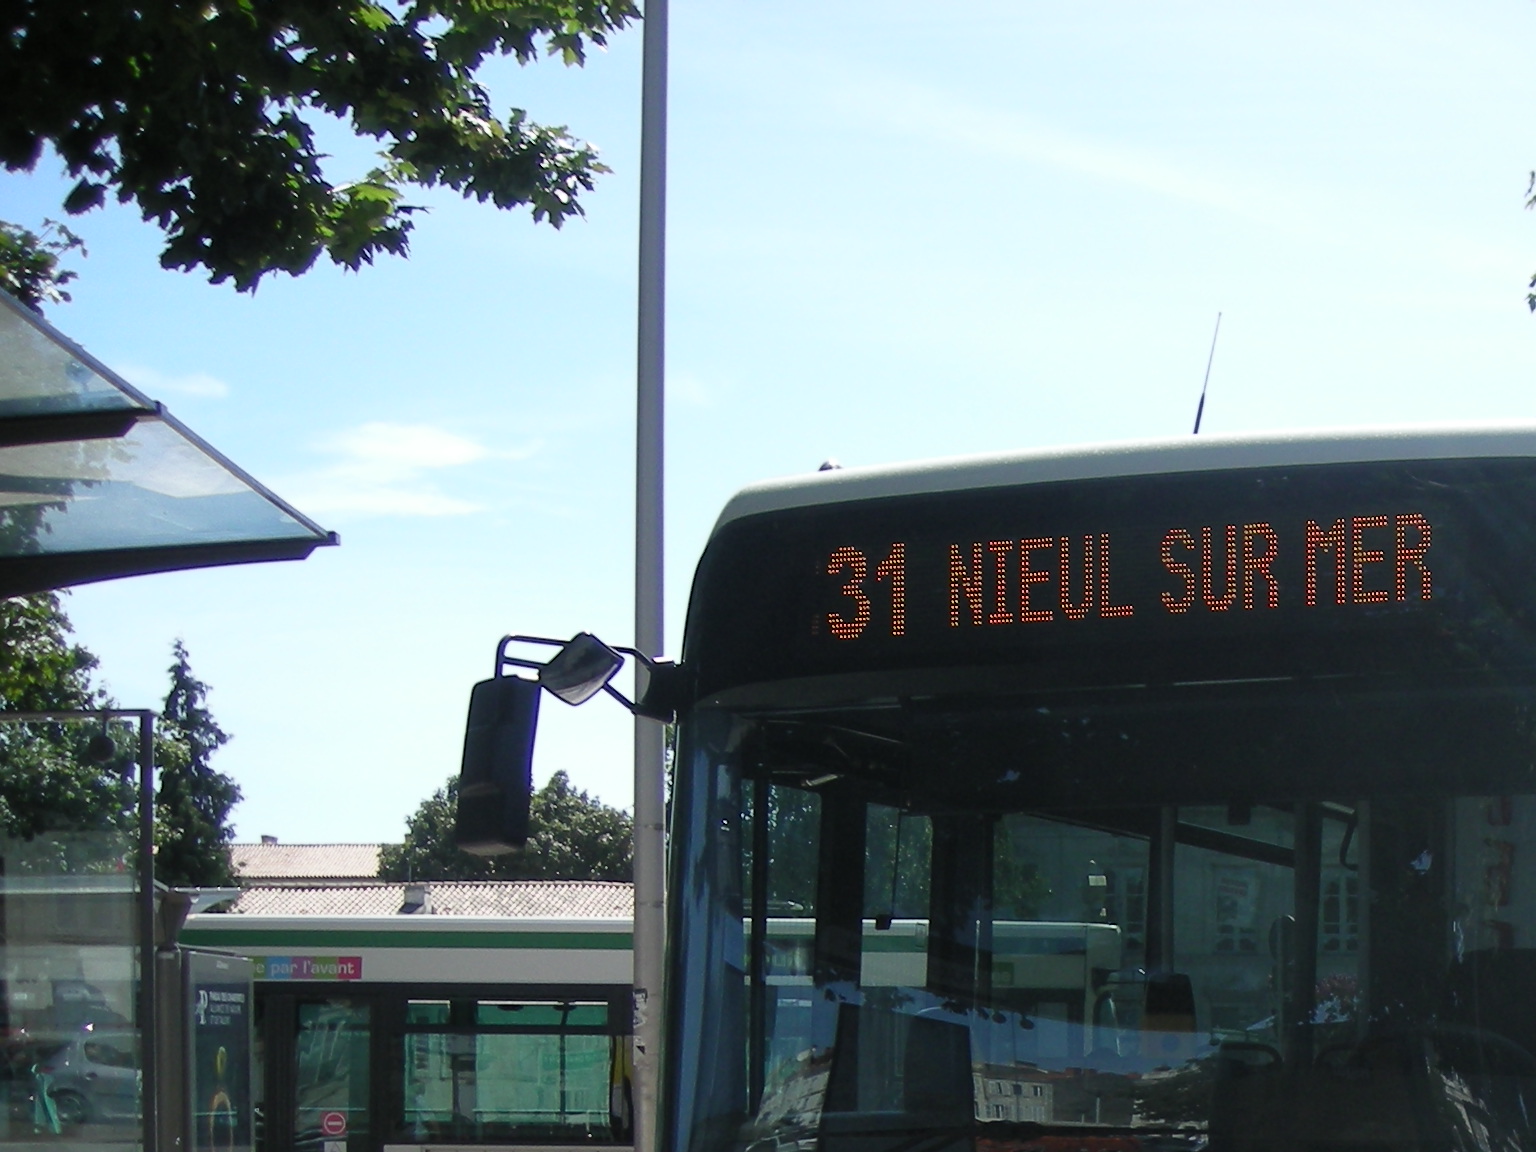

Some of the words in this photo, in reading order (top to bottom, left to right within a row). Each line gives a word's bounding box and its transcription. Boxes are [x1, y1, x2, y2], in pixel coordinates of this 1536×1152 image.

[827, 542, 905, 640] 31
[950, 532, 1135, 627] NIEUL
[1161, 522, 1279, 613] SUR
[1306, 513, 1432, 606] MER
[270, 962, 298, 976] par
[303, 960, 355, 975] l'avant
